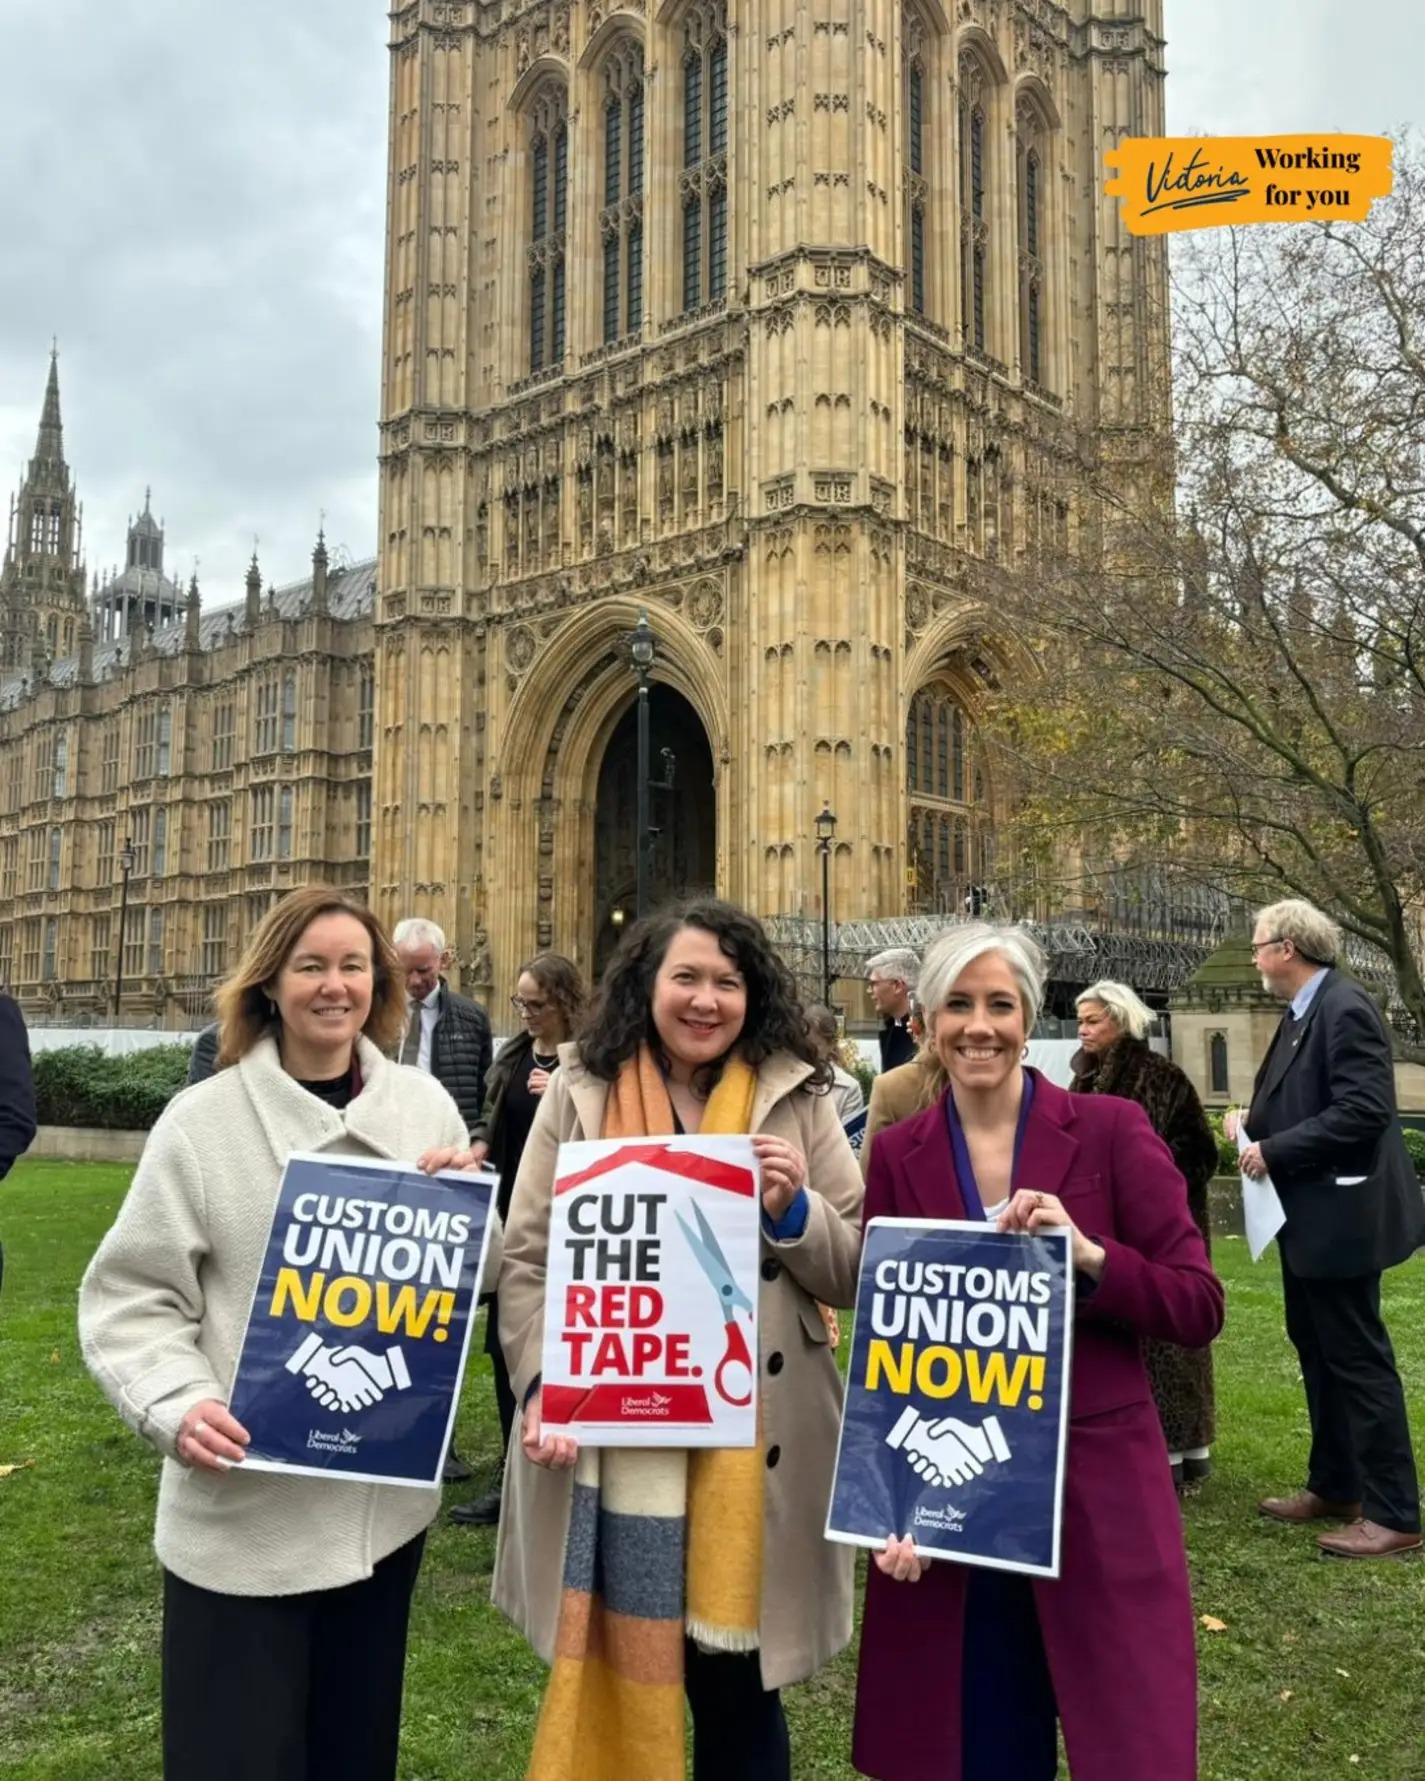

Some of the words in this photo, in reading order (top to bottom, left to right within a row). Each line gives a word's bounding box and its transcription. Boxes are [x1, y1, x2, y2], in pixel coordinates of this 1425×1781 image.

[292, 1192, 472, 1244] CUSTOMS
[567, 1194, 668, 1236] CUT
[282, 1223, 465, 1290] UNION
[564, 1239, 661, 1282] THE
[875, 1259, 1052, 1305] CUSTOMS
[269, 1267, 456, 1342] NOW!
[564, 1285, 664, 1329] RED
[870, 1293, 1049, 1353] UNION
[561, 1332, 703, 1378] TAPE.
[864, 1339, 1047, 1411] NOW!
[620, 1406, 670, 1416] Democrats
[621, 1396, 650, 1406] Liberal
[306, 1439, 357, 1454] Democrats
[309, 1429, 340, 1442] Liberal
[913, 1515, 963, 1532] Democrats
[914, 1505, 944, 1519] Liberal
